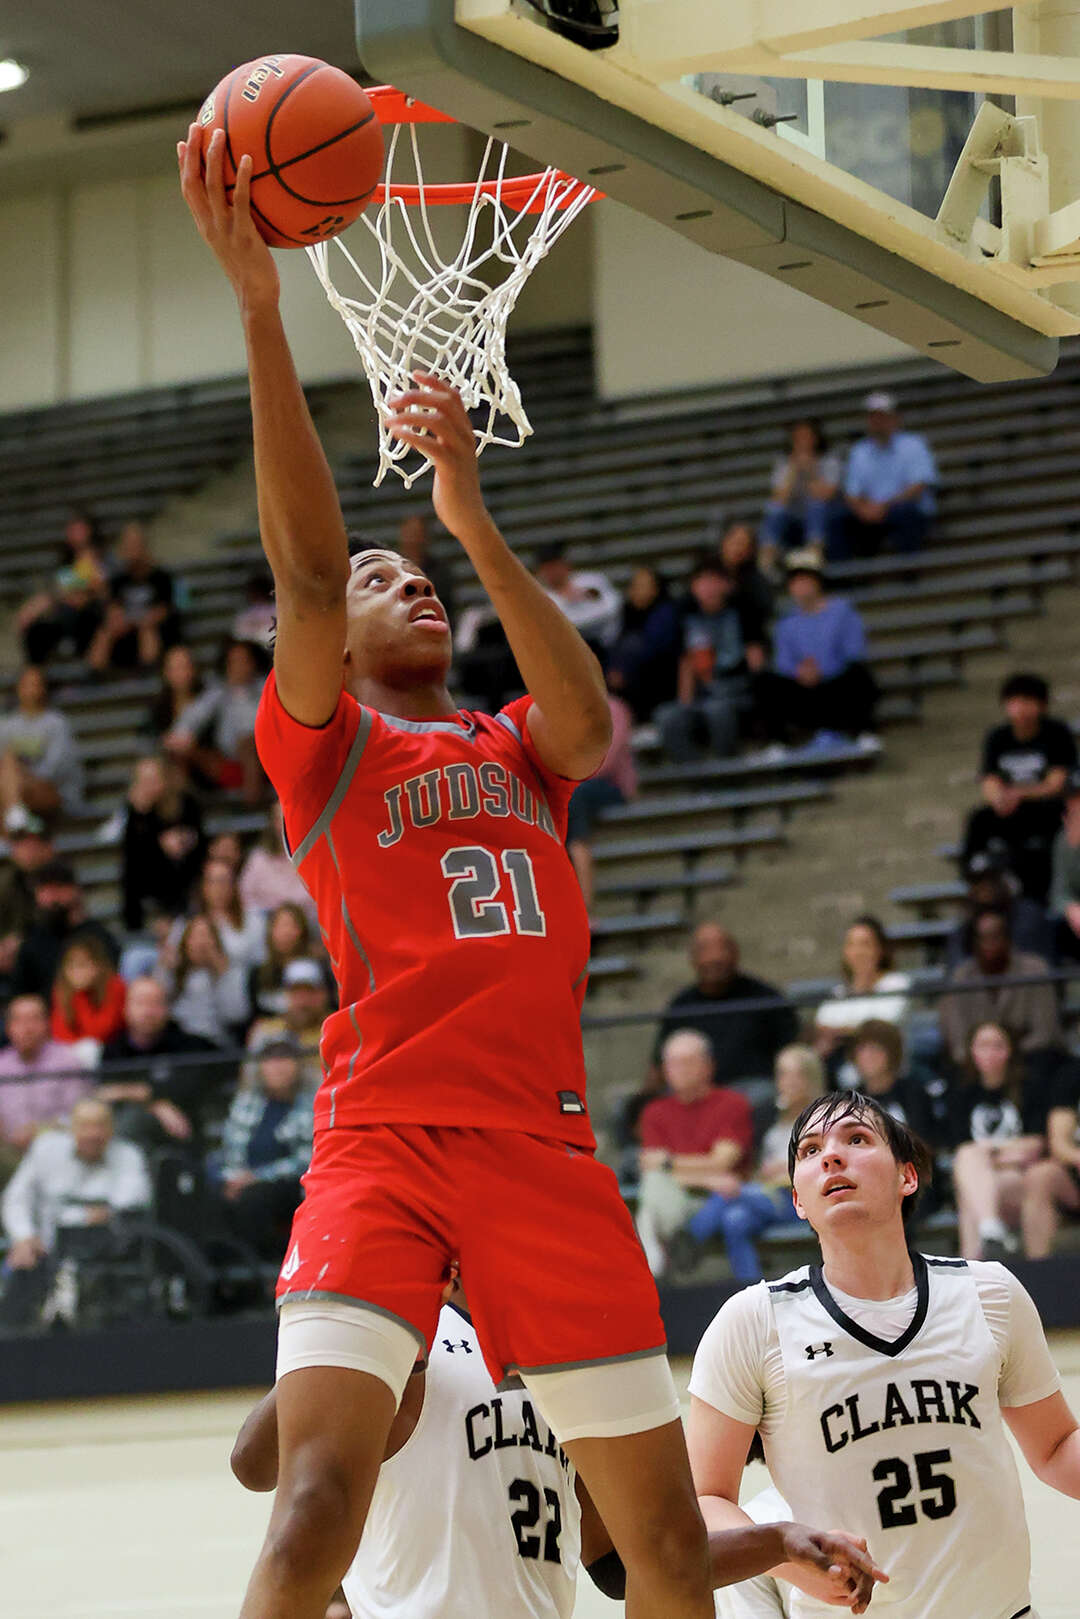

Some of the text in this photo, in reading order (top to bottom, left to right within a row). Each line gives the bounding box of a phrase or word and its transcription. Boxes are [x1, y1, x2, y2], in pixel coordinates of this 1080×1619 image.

[440, 846, 546, 939] 21
[465, 1398, 570, 1473] CLA
[820, 1379, 981, 1454] CLARK
[872, 1448, 957, 1530] 25
